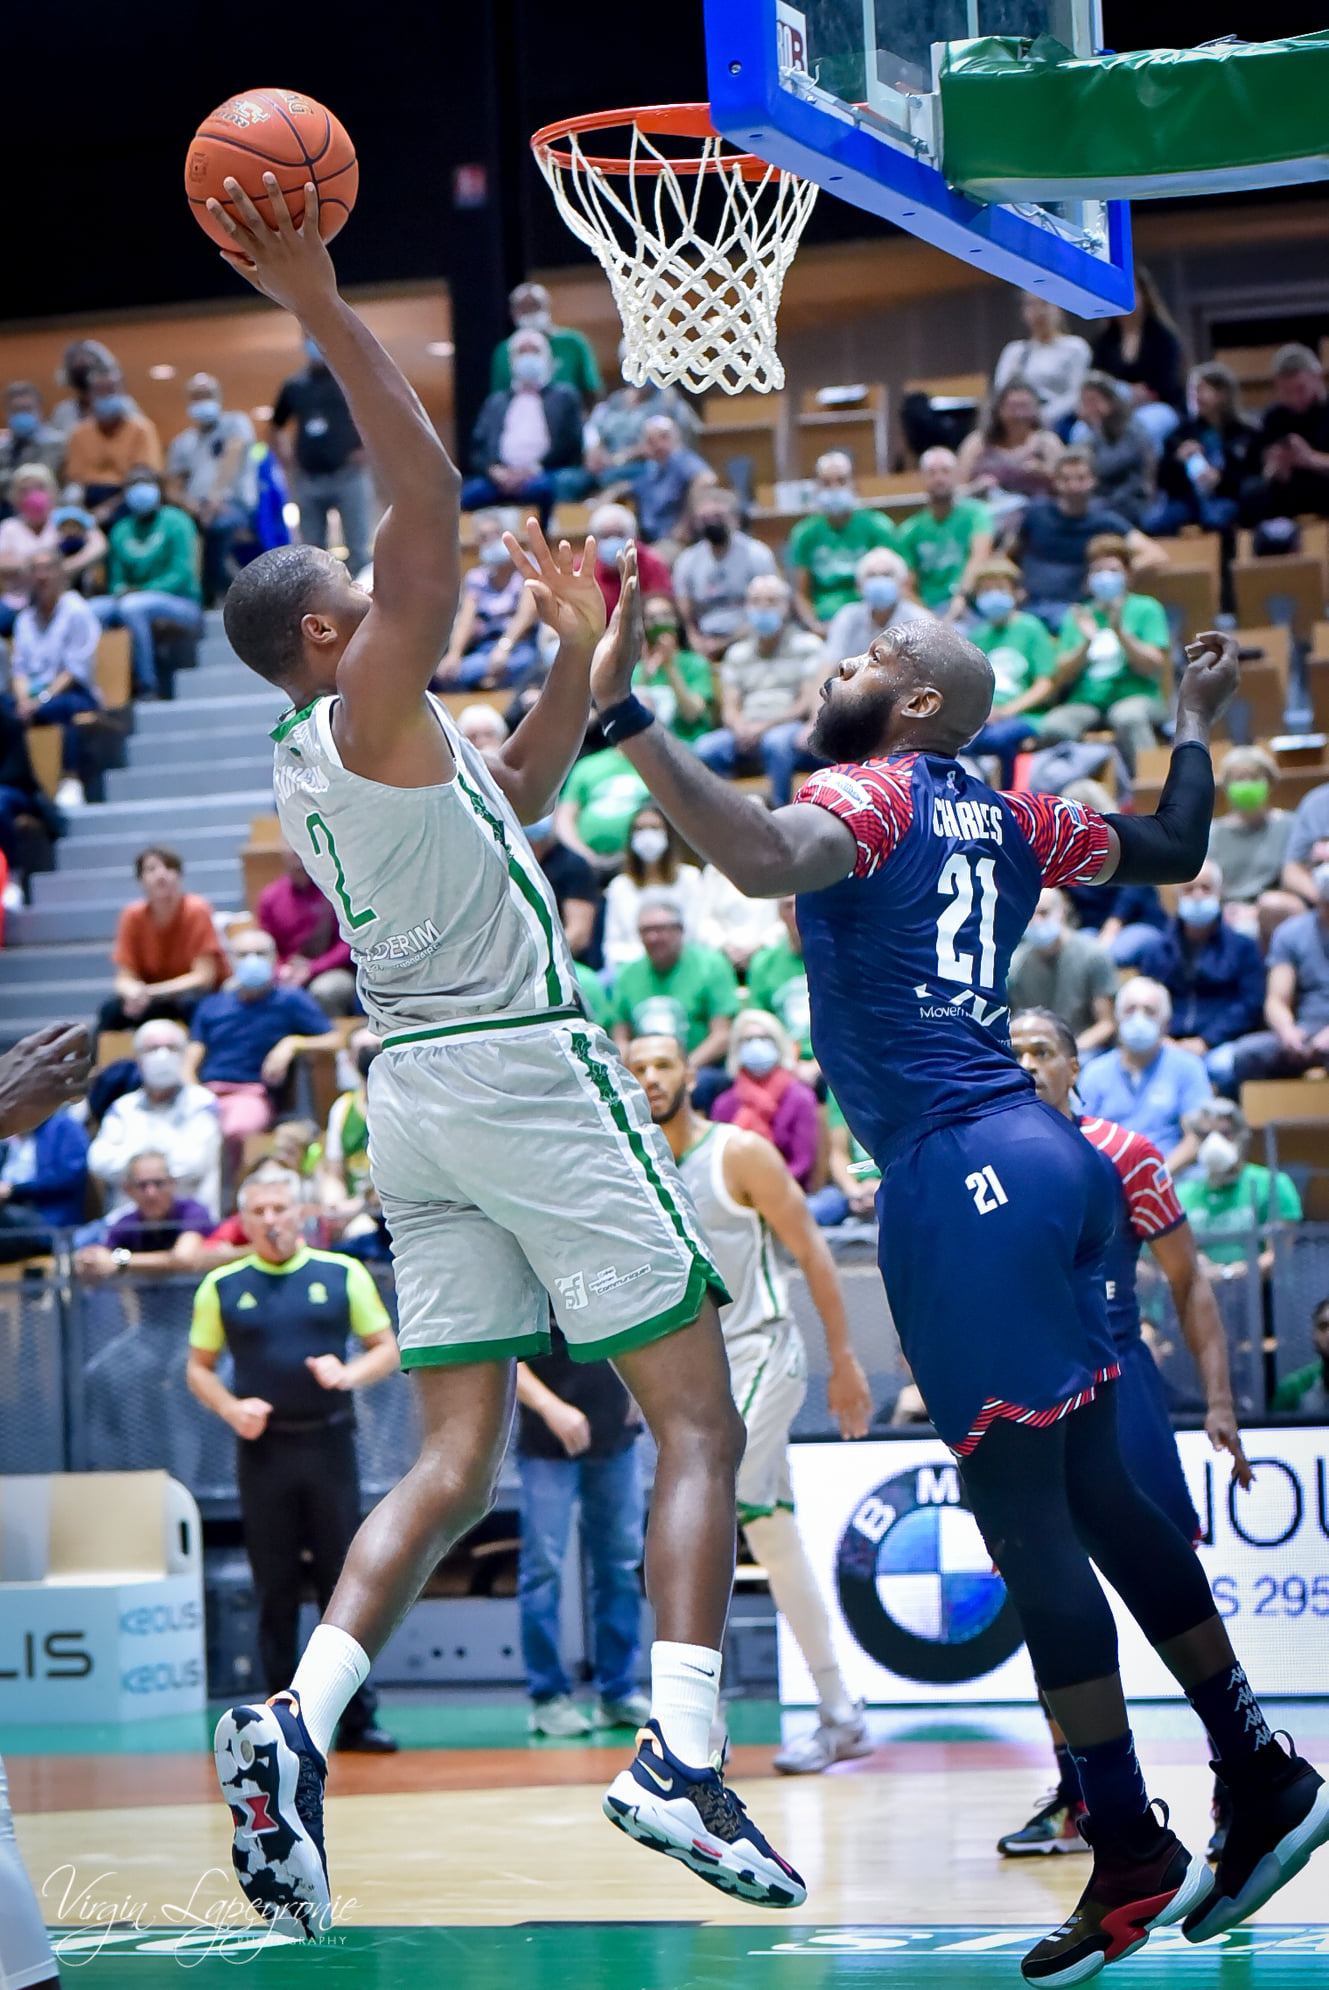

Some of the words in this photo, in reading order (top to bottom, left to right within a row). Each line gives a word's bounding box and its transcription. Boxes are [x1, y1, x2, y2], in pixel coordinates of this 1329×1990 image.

[933, 797, 1003, 846] CHRLES
[306, 811, 380, 932] 2
[936, 853, 998, 988] 21
[965, 1165, 1009, 1215] 21
[852, 1466, 961, 1545] BM
